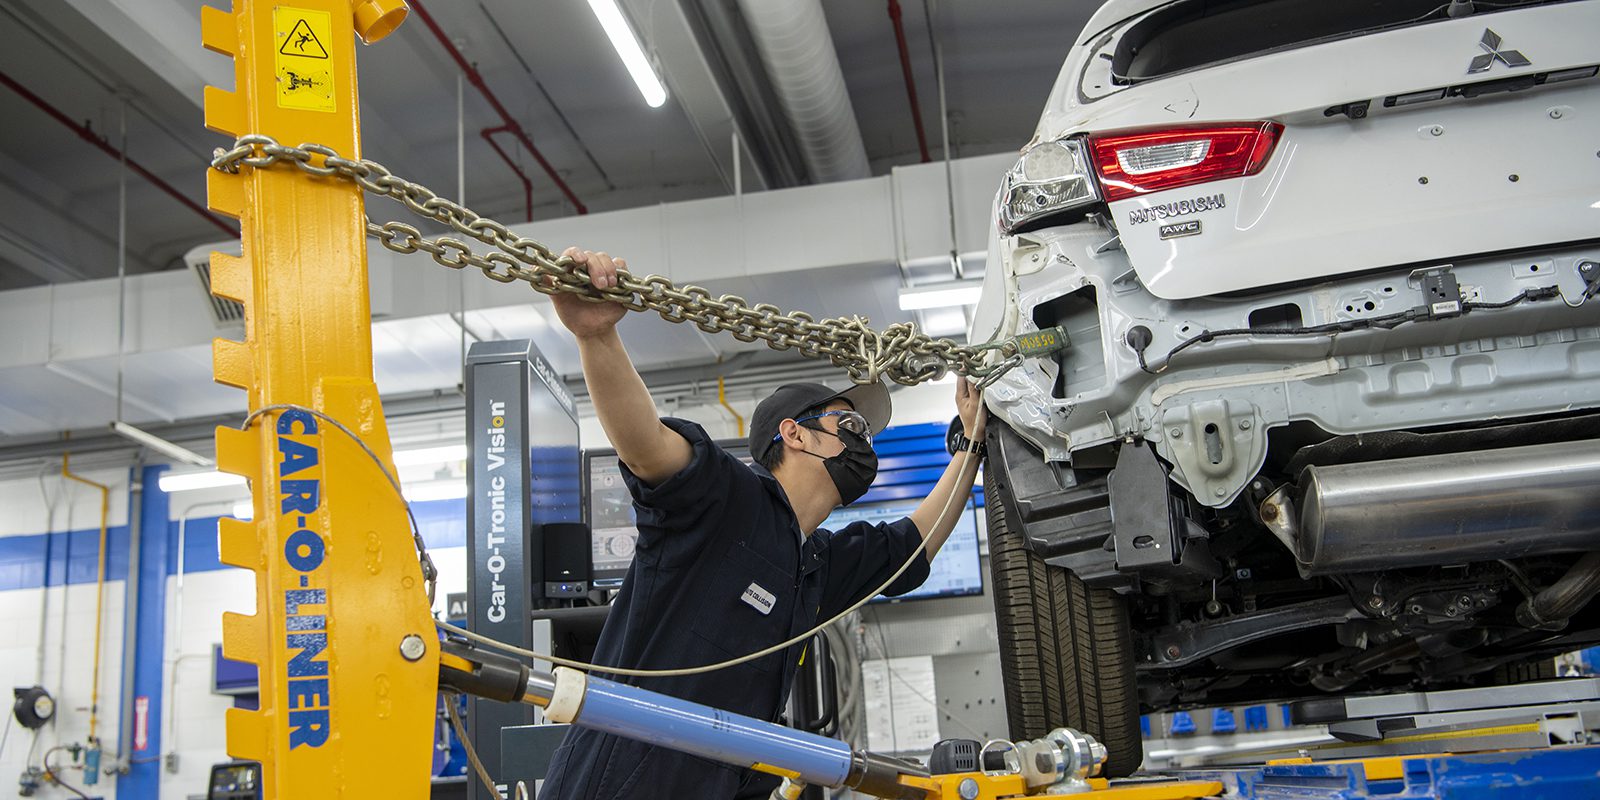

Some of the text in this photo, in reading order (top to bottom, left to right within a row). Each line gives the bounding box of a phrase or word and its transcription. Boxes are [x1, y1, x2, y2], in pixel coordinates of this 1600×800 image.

[1129, 193, 1226, 226] MITSUBISHI
[1162, 221, 1199, 235] AWC
[276, 408, 331, 752] CAR-O-LINER
[487, 475, 506, 623] Car-O-Tronic
